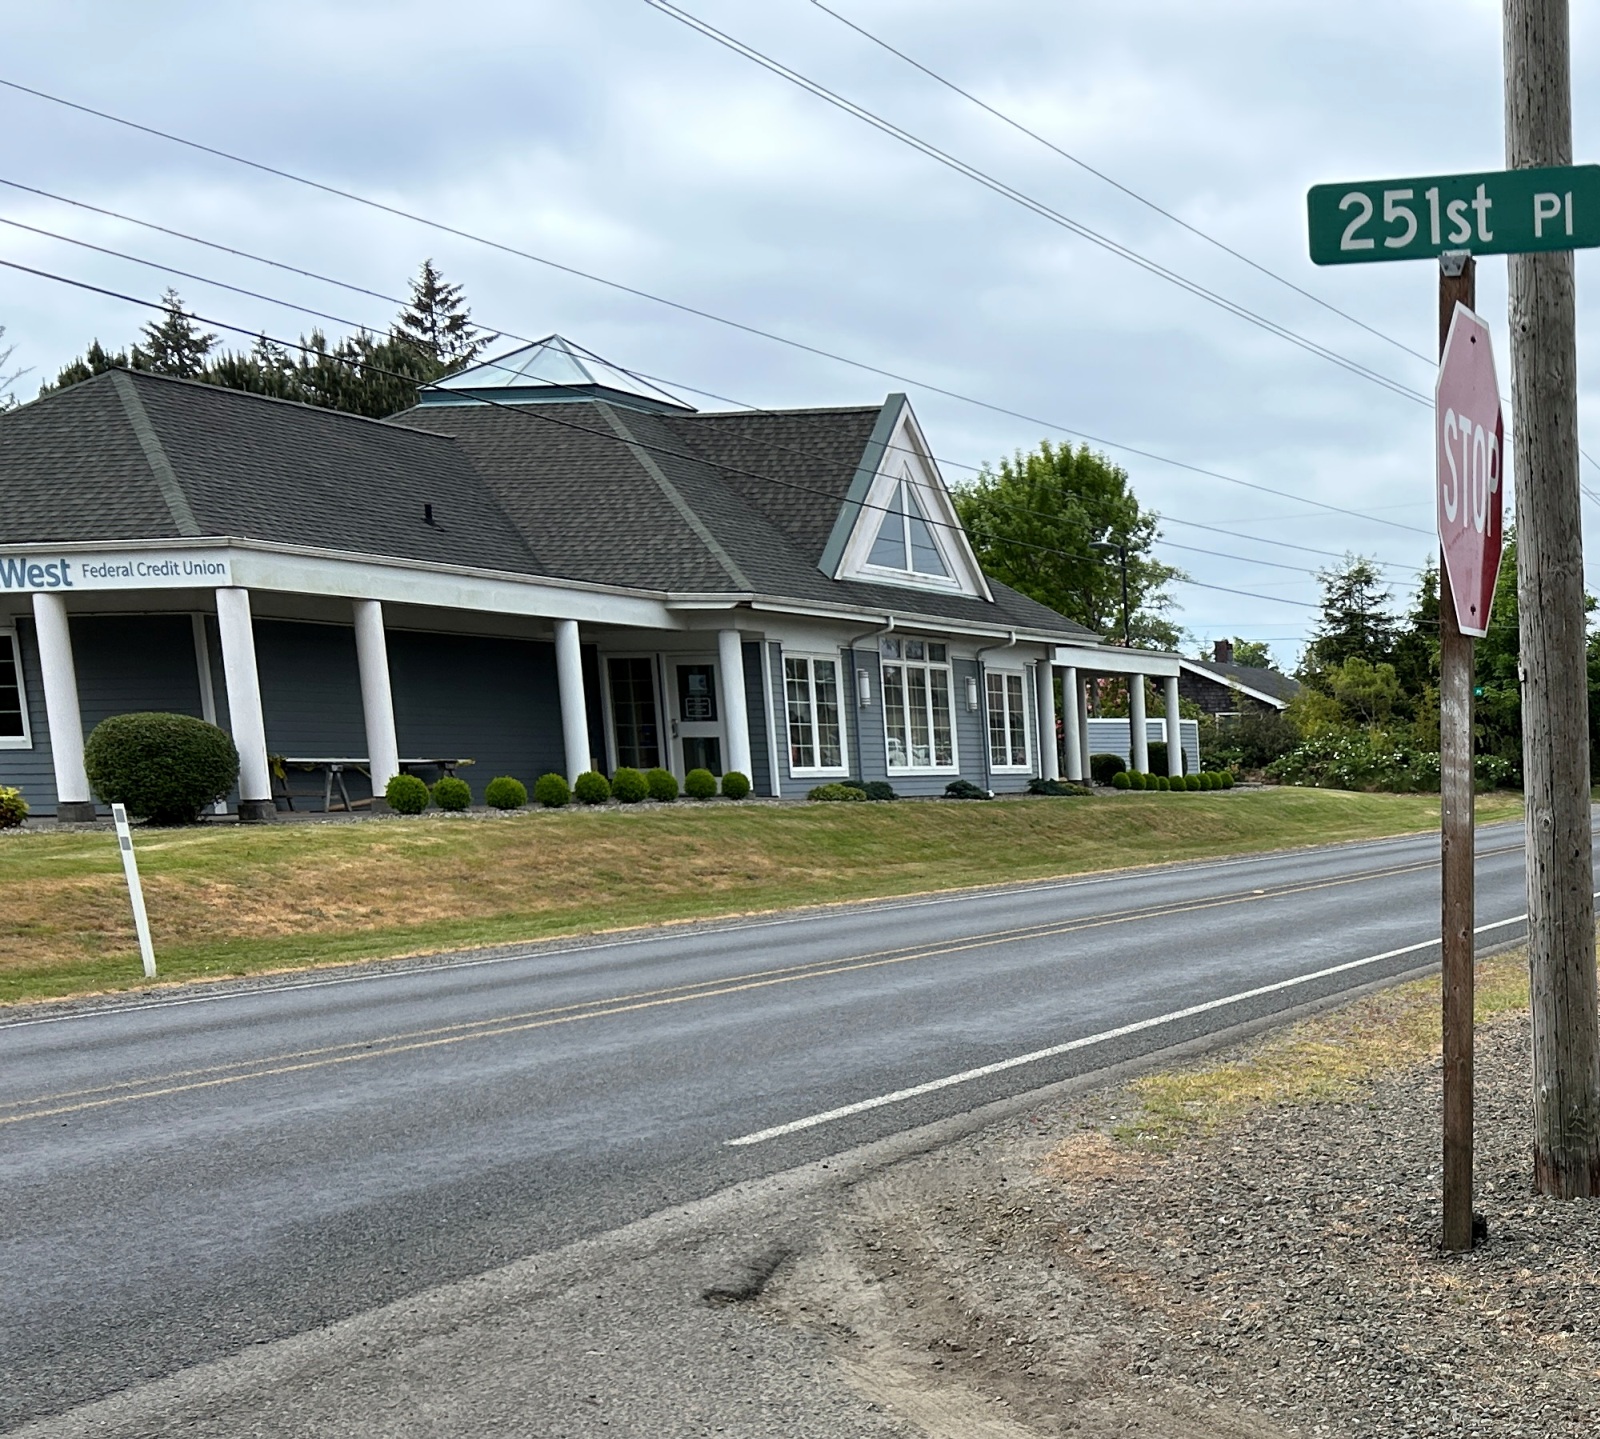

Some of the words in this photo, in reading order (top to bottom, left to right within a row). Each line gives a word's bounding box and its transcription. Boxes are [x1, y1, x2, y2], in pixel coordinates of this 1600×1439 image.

[1338, 183, 1493, 251] 251st
[1443, 407, 1500, 537] STOP
[0, 558, 73, 588] West
[82, 561, 134, 578] Federal
[137, 559, 181, 577] Credit
[183, 559, 226, 576] Union
